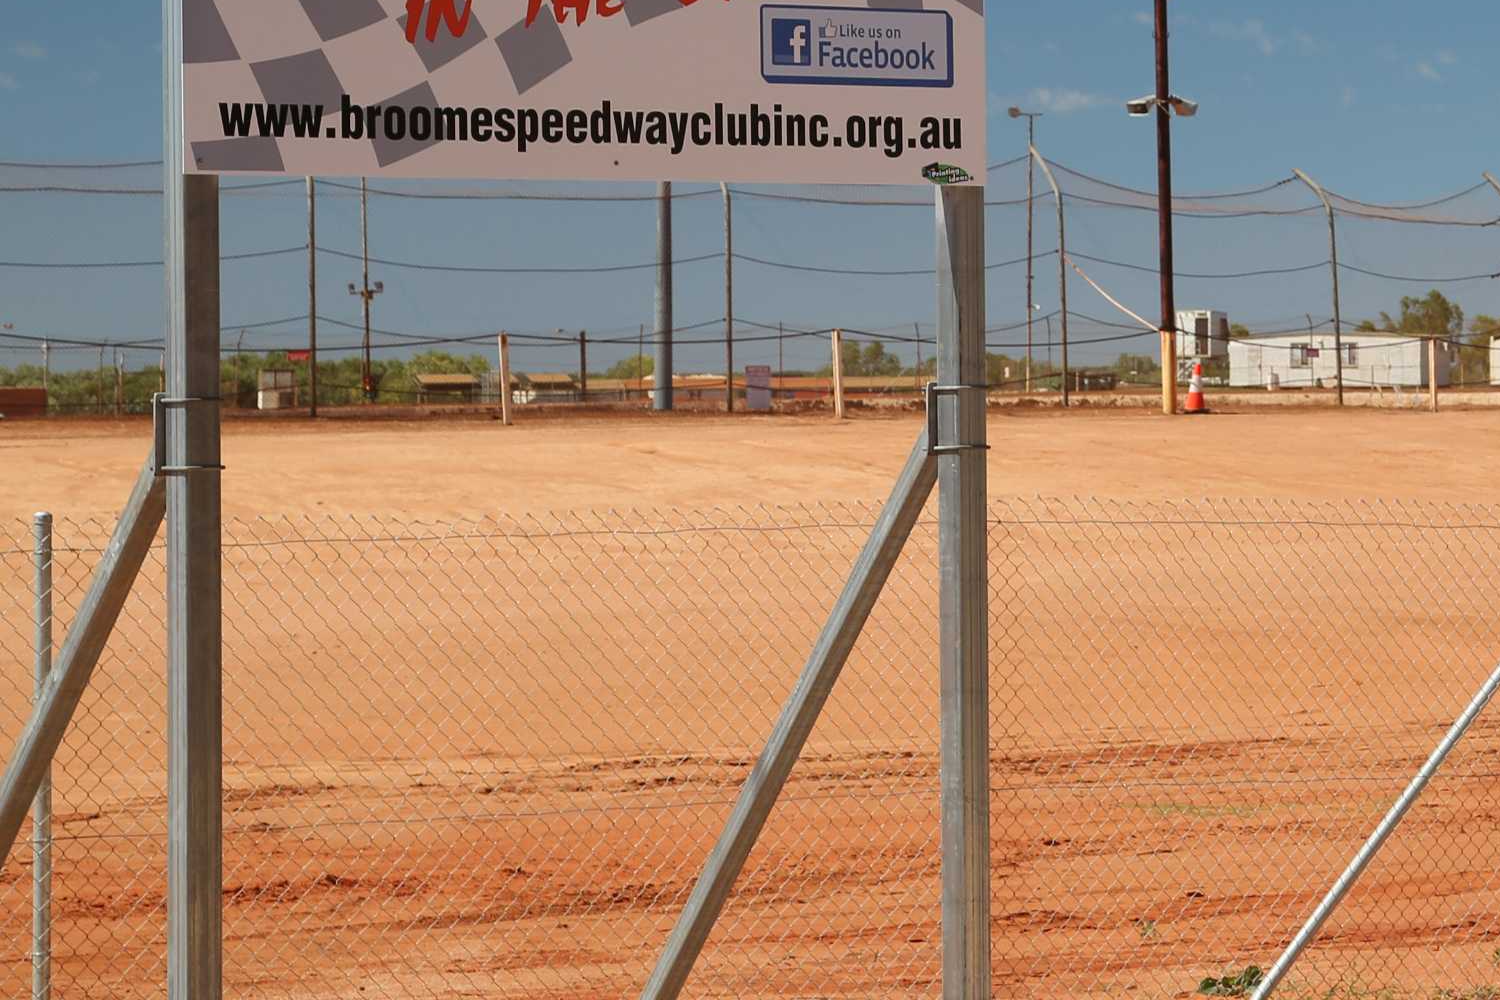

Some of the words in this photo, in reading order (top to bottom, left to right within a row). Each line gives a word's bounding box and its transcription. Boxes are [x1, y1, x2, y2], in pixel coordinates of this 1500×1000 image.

[839, 24, 865, 38] Like
[869, 26, 883, 39] us
[886, 28, 901, 39] on
[818, 40, 936, 70] Facebook
[218, 93, 963, 158] www.broomespeedwayclubinc.org.au
